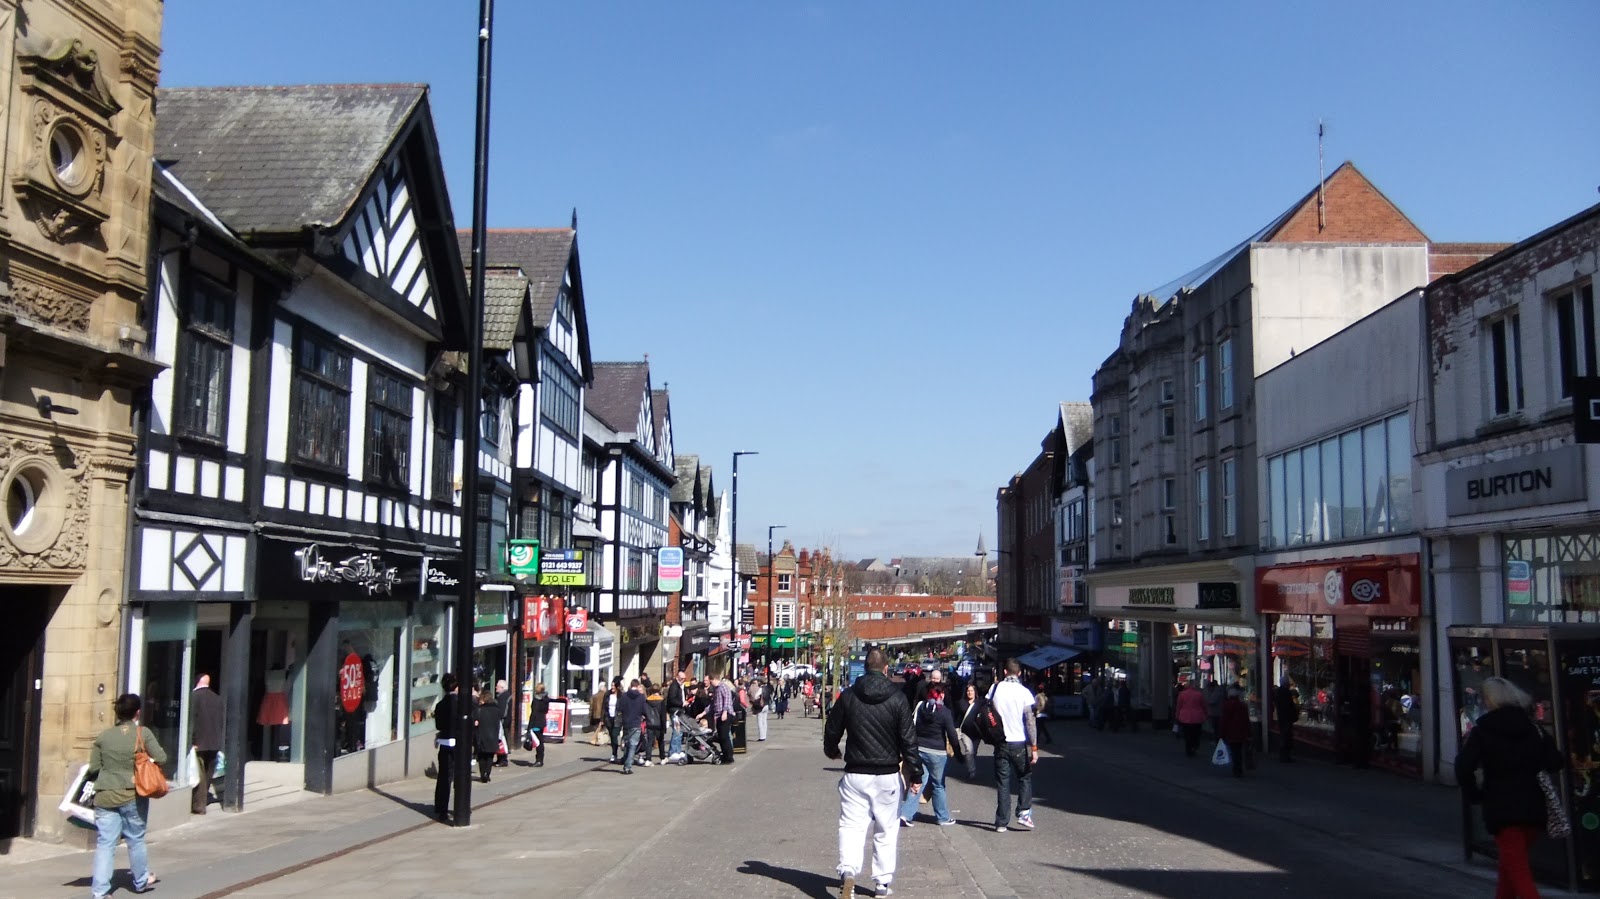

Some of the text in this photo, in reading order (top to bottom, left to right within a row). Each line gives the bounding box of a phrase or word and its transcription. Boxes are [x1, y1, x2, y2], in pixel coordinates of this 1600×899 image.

[1467, 467, 1552, 500] BURTON
[541, 561, 556, 569] 0121
[556, 561, 568, 569] 643
[547, 575, 577, 583] TO LET
[1567, 666, 1588, 675] SAVE
[343, 687, 361, 701] SALE
